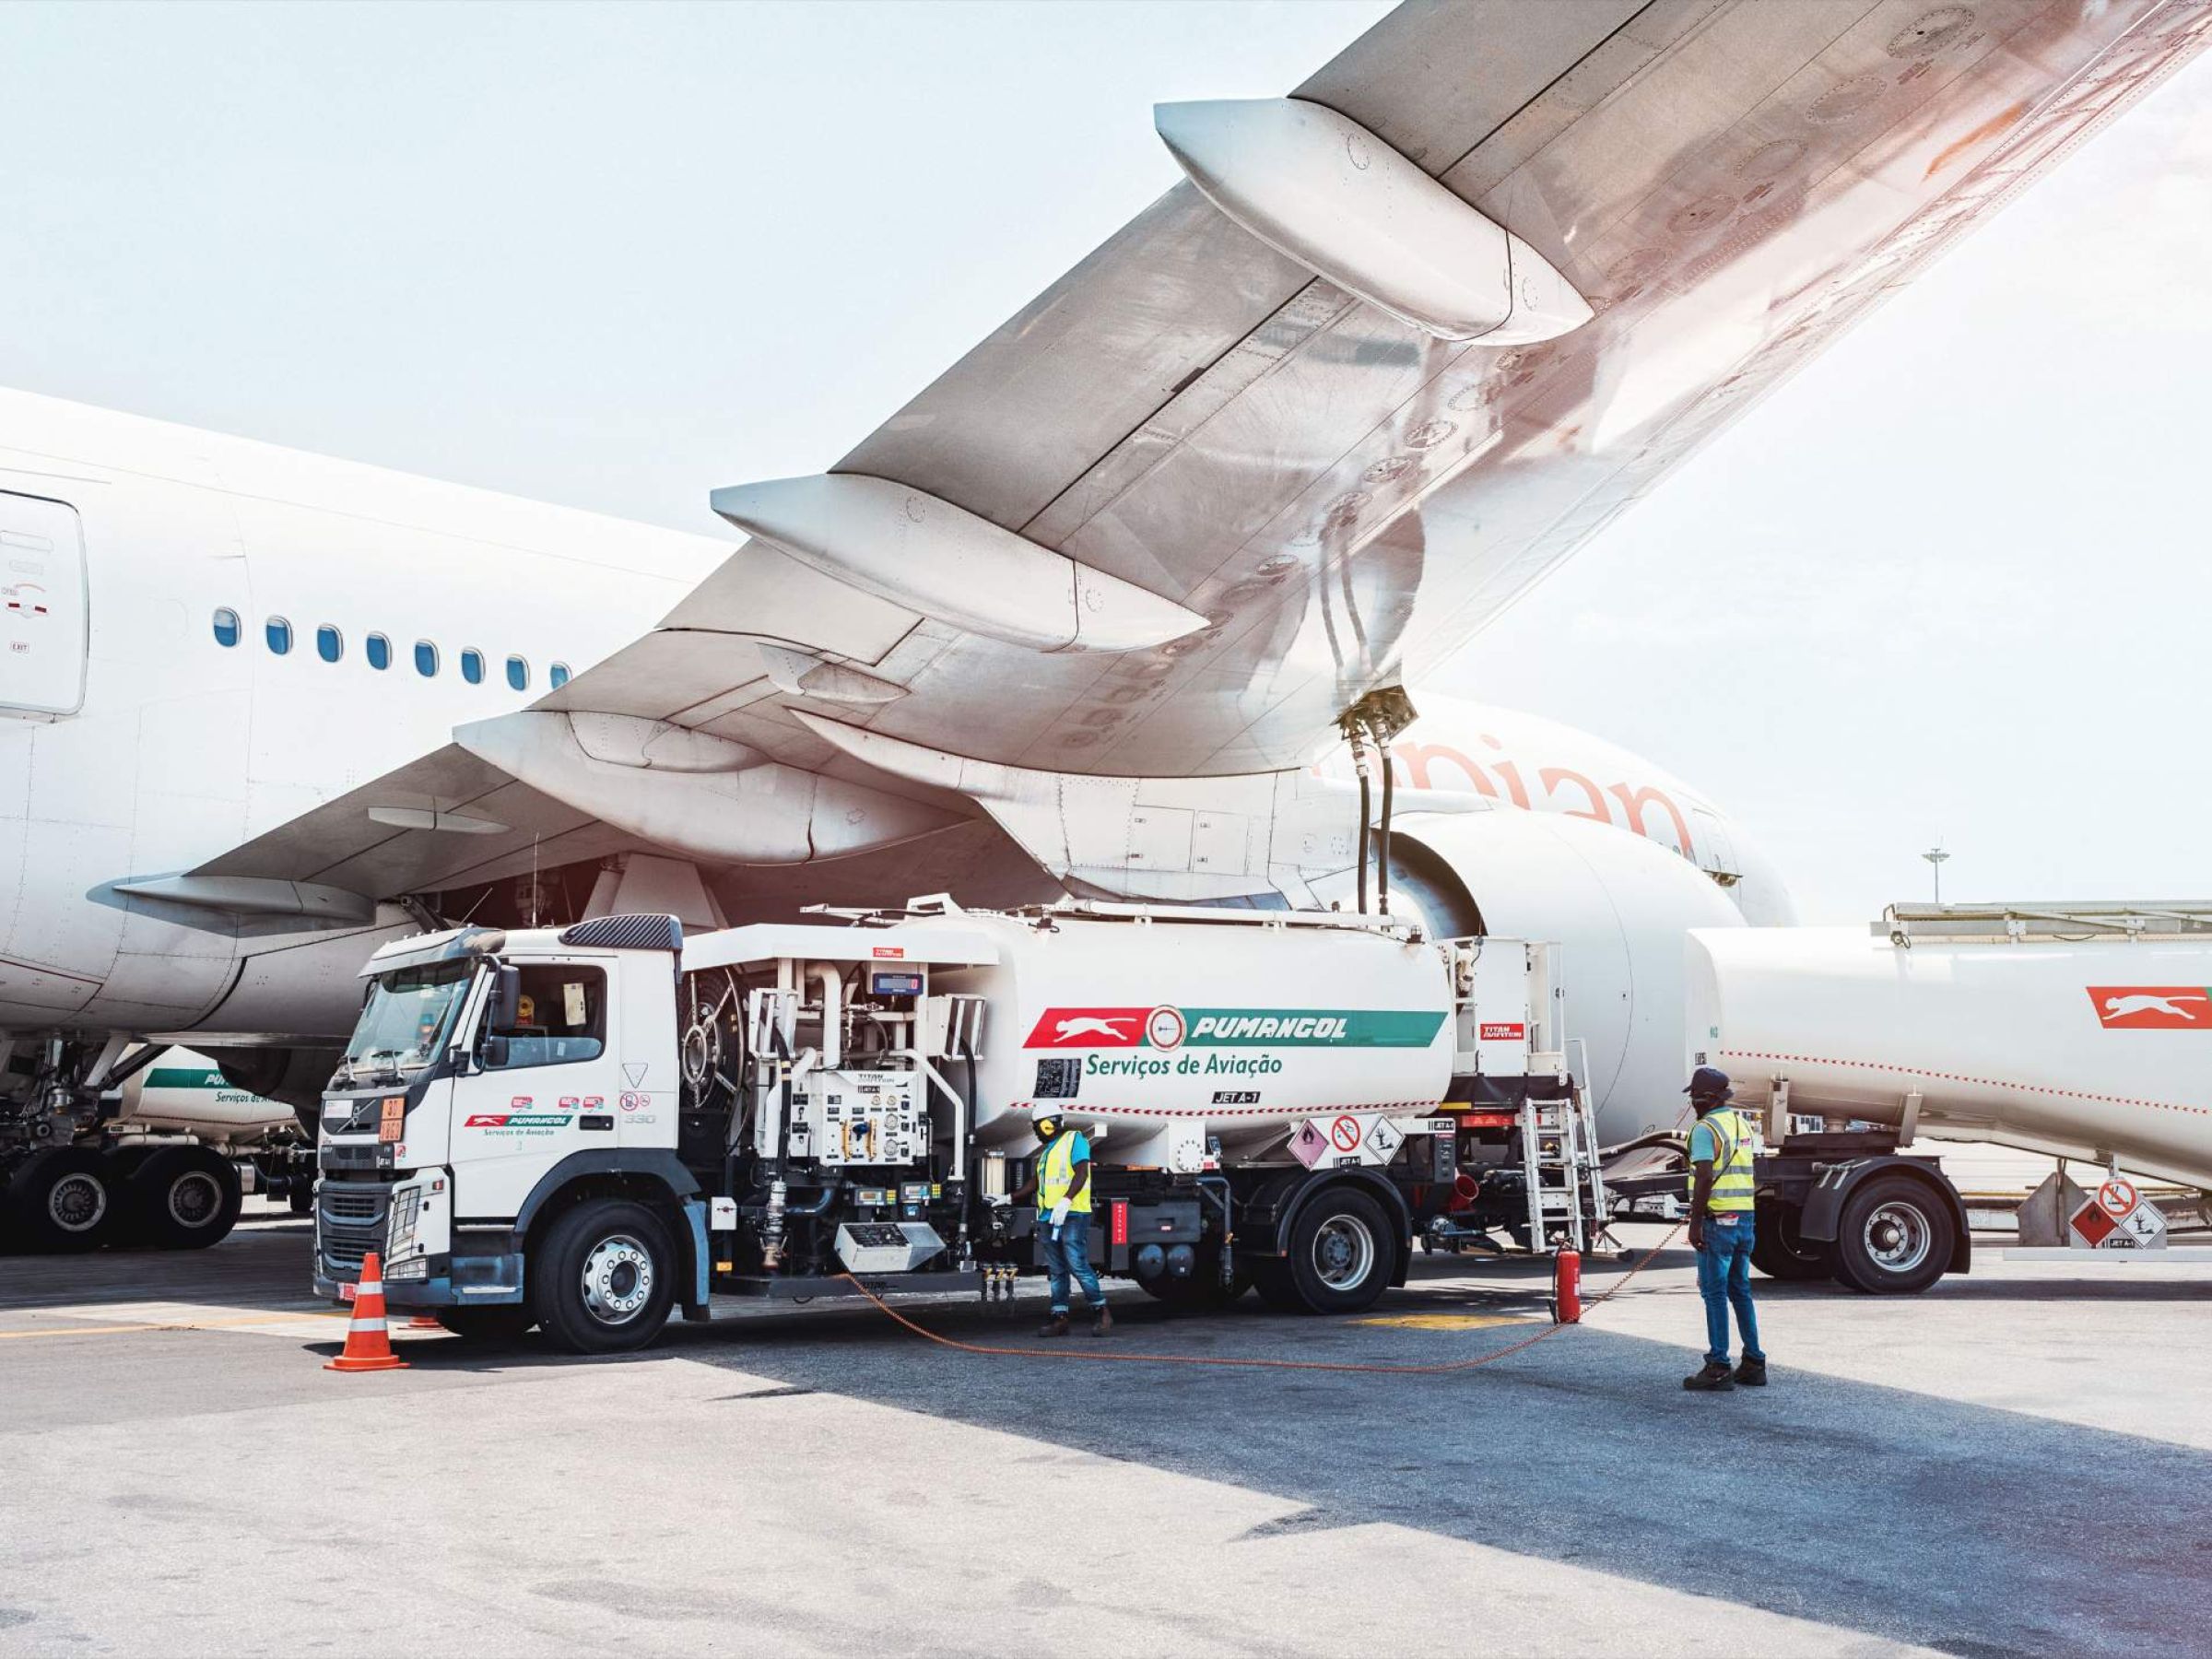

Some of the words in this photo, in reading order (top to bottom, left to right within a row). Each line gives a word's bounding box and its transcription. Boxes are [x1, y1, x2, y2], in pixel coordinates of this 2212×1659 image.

[1191, 1017, 1347, 1039] PUMANGOL
[1086, 1053, 1171, 1079] Serviços
[1176, 1054, 1200, 1075] de
[1206, 1053, 1283, 1078] Aviação
[215, 1091, 249, 1103] Serviços
[1216, 1093, 1238, 1102] JET
[1238, 1093, 1257, 1102] A-1
[526, 1128, 554, 1136] Aviação
